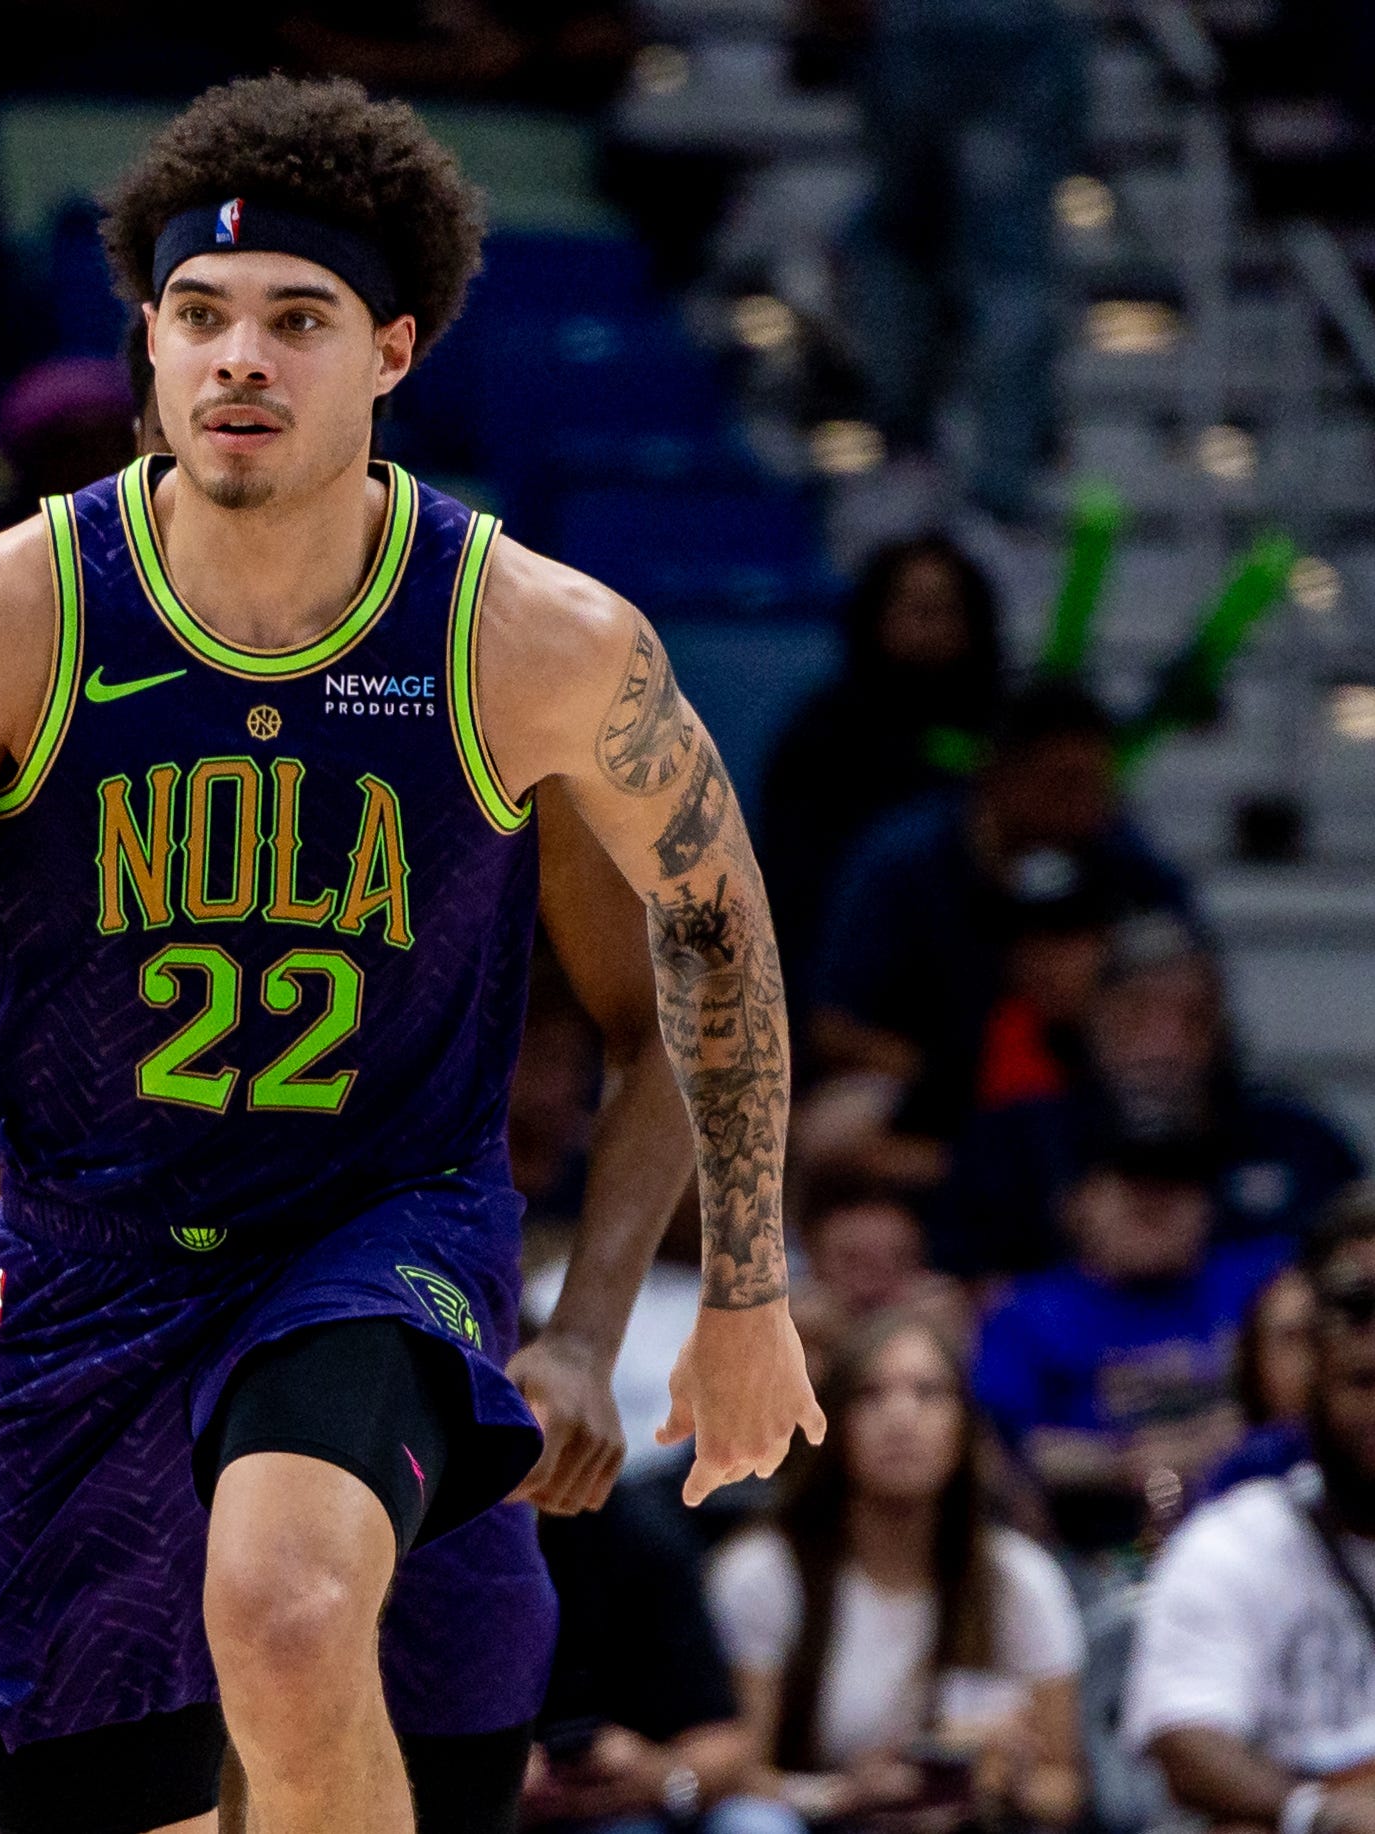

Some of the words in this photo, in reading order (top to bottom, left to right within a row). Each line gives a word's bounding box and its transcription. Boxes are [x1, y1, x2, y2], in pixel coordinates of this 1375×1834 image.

[325, 674, 435, 697] NEWAGE
[325, 701, 435, 717] PRODUCTS
[95, 755, 415, 950] NOLA
[135, 943, 365, 1115] 22
